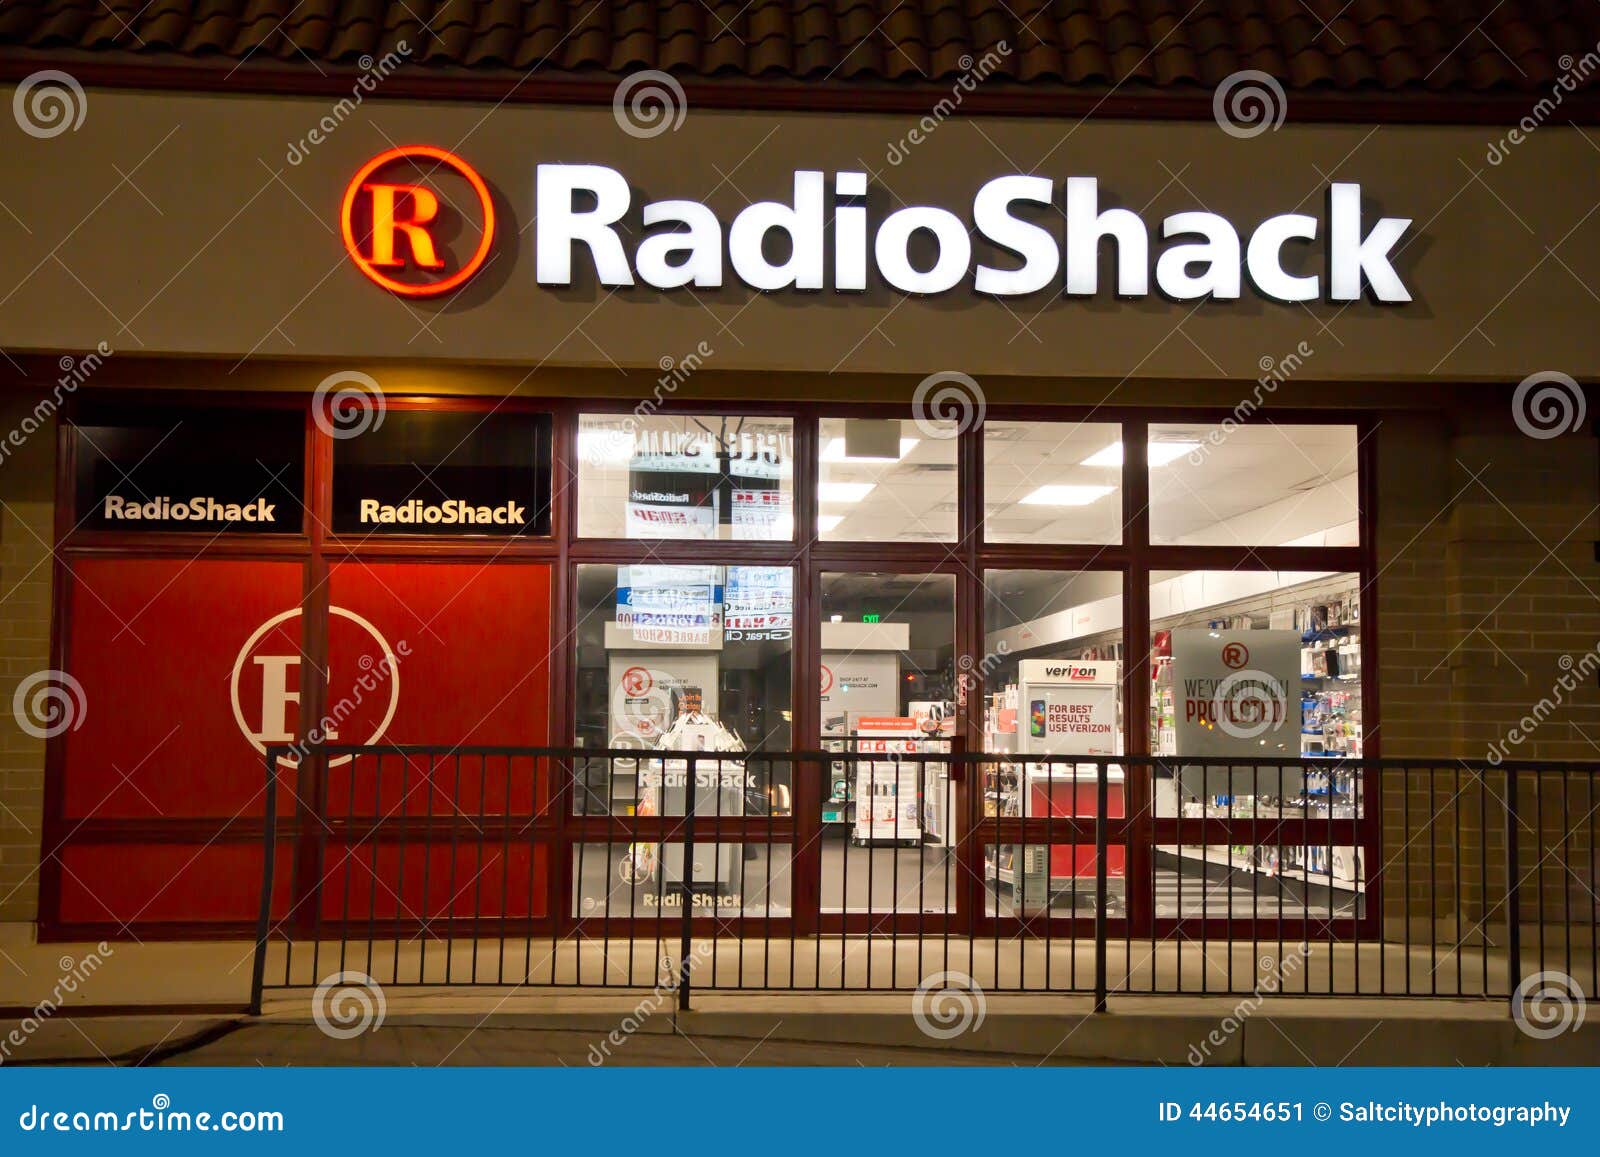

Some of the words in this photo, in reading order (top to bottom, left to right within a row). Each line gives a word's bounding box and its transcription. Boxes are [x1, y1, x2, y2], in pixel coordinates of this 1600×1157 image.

[536, 163, 1413, 303] RadioShack
[104, 495, 276, 522] RadioShack
[359, 499, 525, 525] RadioShack
[1045, 665, 1097, 680] verizon
[1049, 704, 1068, 714] FOR
[1069, 704, 1093, 714] BEST
[1049, 714, 1090, 723] RESULTS
[1049, 724, 1068, 733] USE
[1069, 724, 1111, 733] VERIZON
